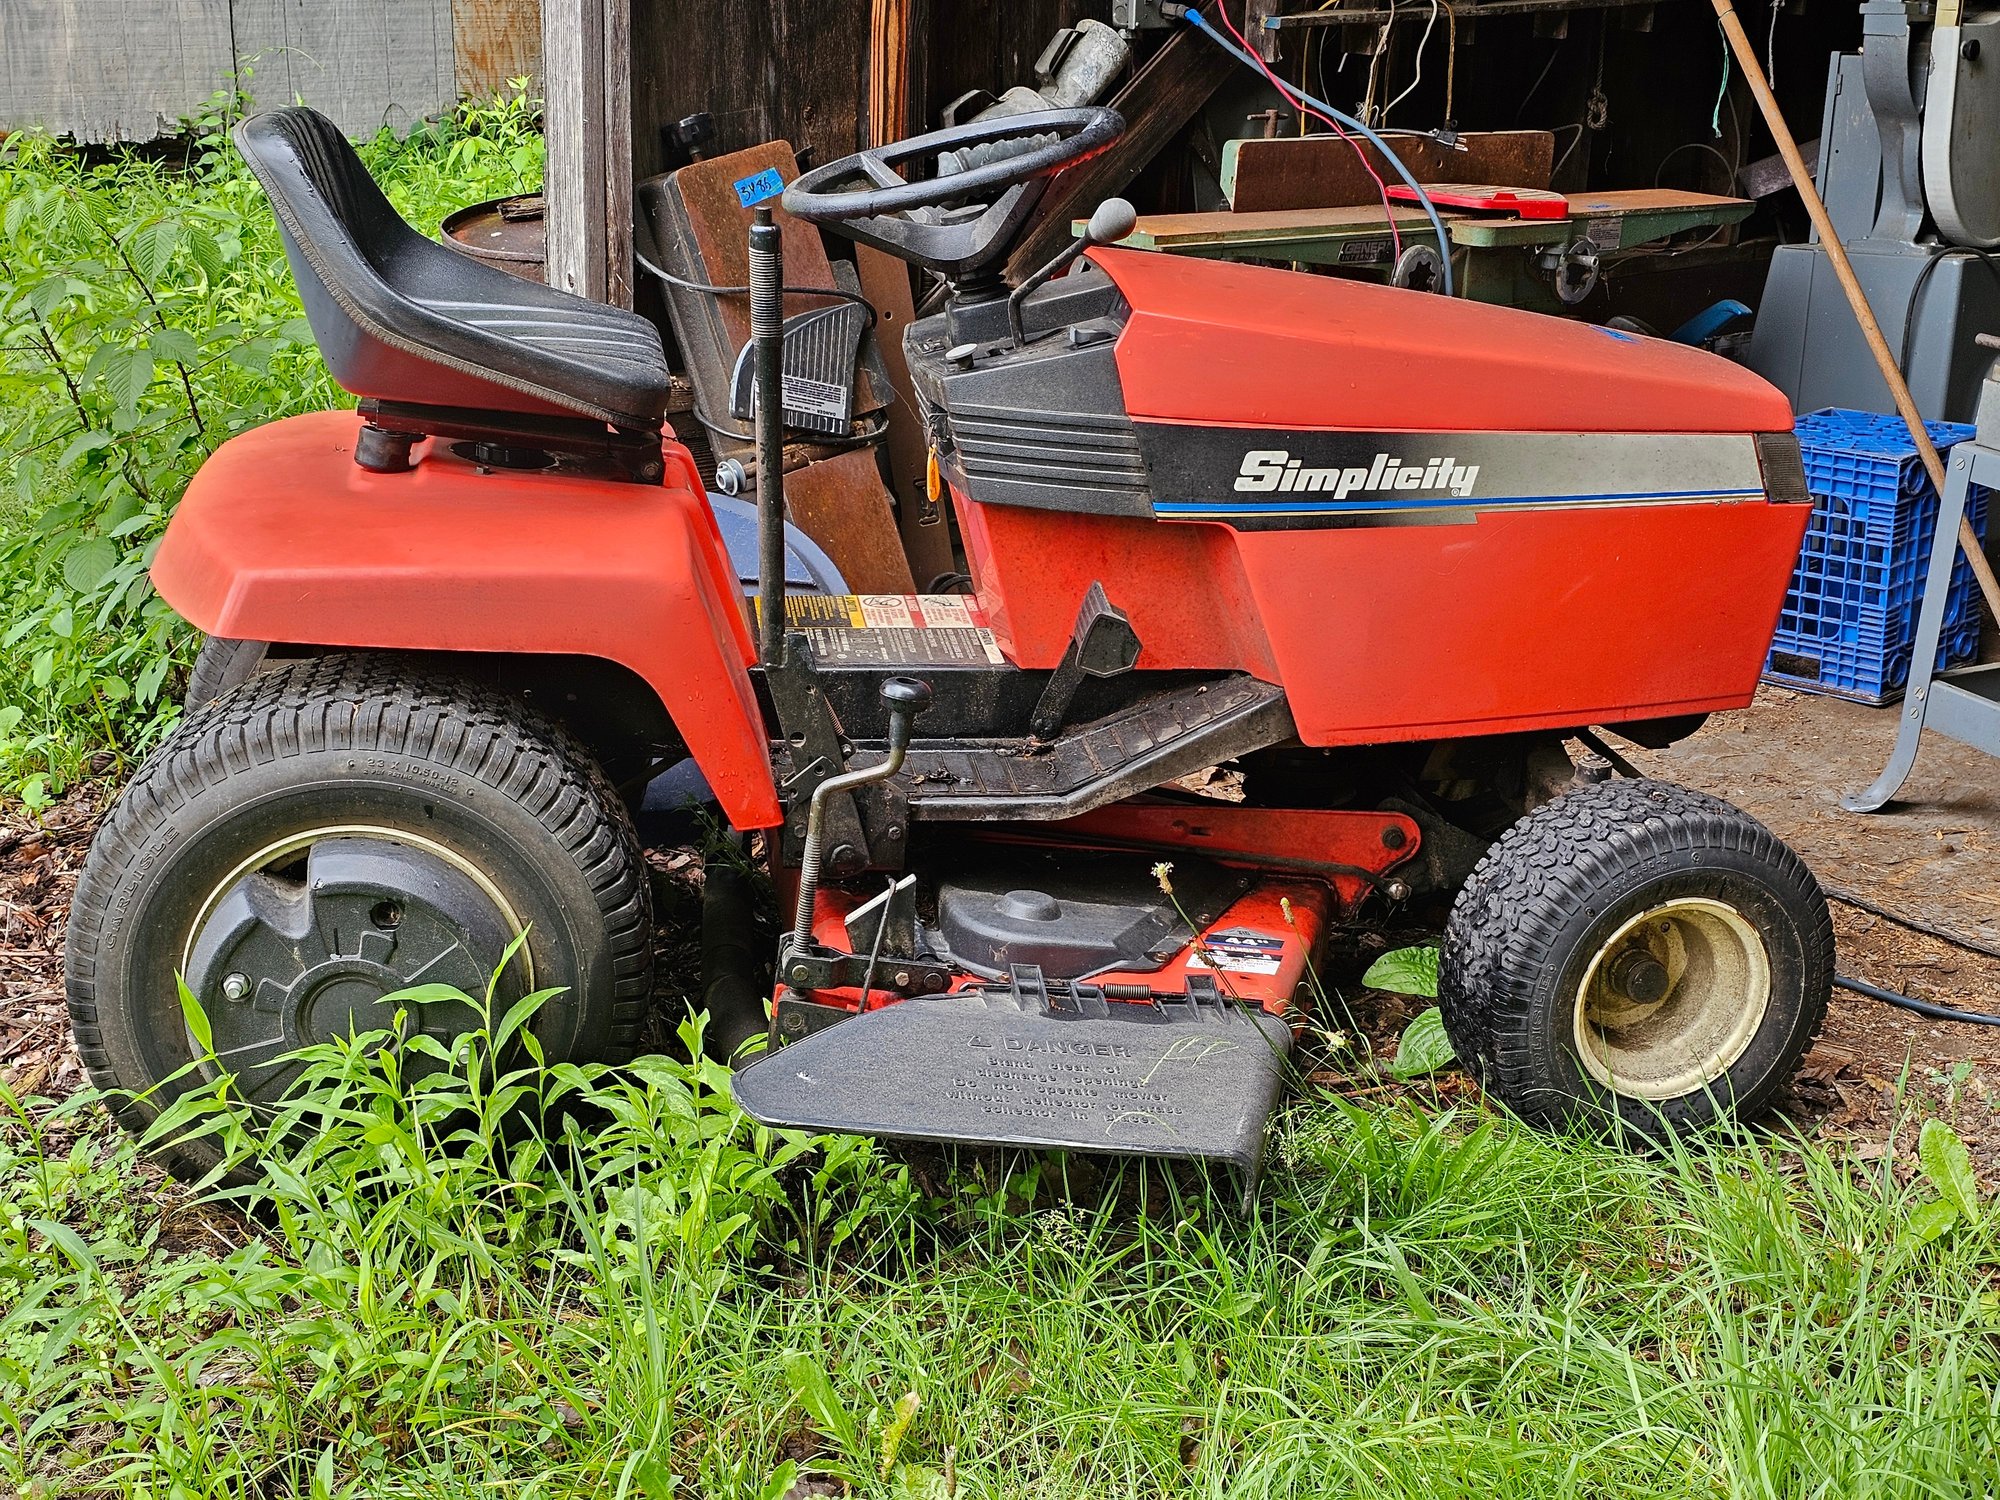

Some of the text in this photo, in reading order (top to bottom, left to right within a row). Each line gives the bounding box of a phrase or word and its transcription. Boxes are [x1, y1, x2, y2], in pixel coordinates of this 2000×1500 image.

[1344, 241, 1392, 253] GENERA
[1234, 451, 1480, 499] Simplicity
[367, 758, 385, 768] 23
[405, 762, 459, 787] 10.50-12
[104, 825, 180, 950] CARLISLE
[1002, 1035, 1132, 1058] DANGER
[976, 1067, 1057, 1083] discharge
[987, 1055, 1121, 1075] Stand clear of
[946, 1090, 1010, 1103] without
[1020, 1096, 1097, 1109] deflector
[1107, 1103, 1126, 1112] or
[953, 1078, 1168, 1102] Do not operate mower
[981, 1106, 1057, 1118] collector
[1071, 1110, 1088, 1121] in
